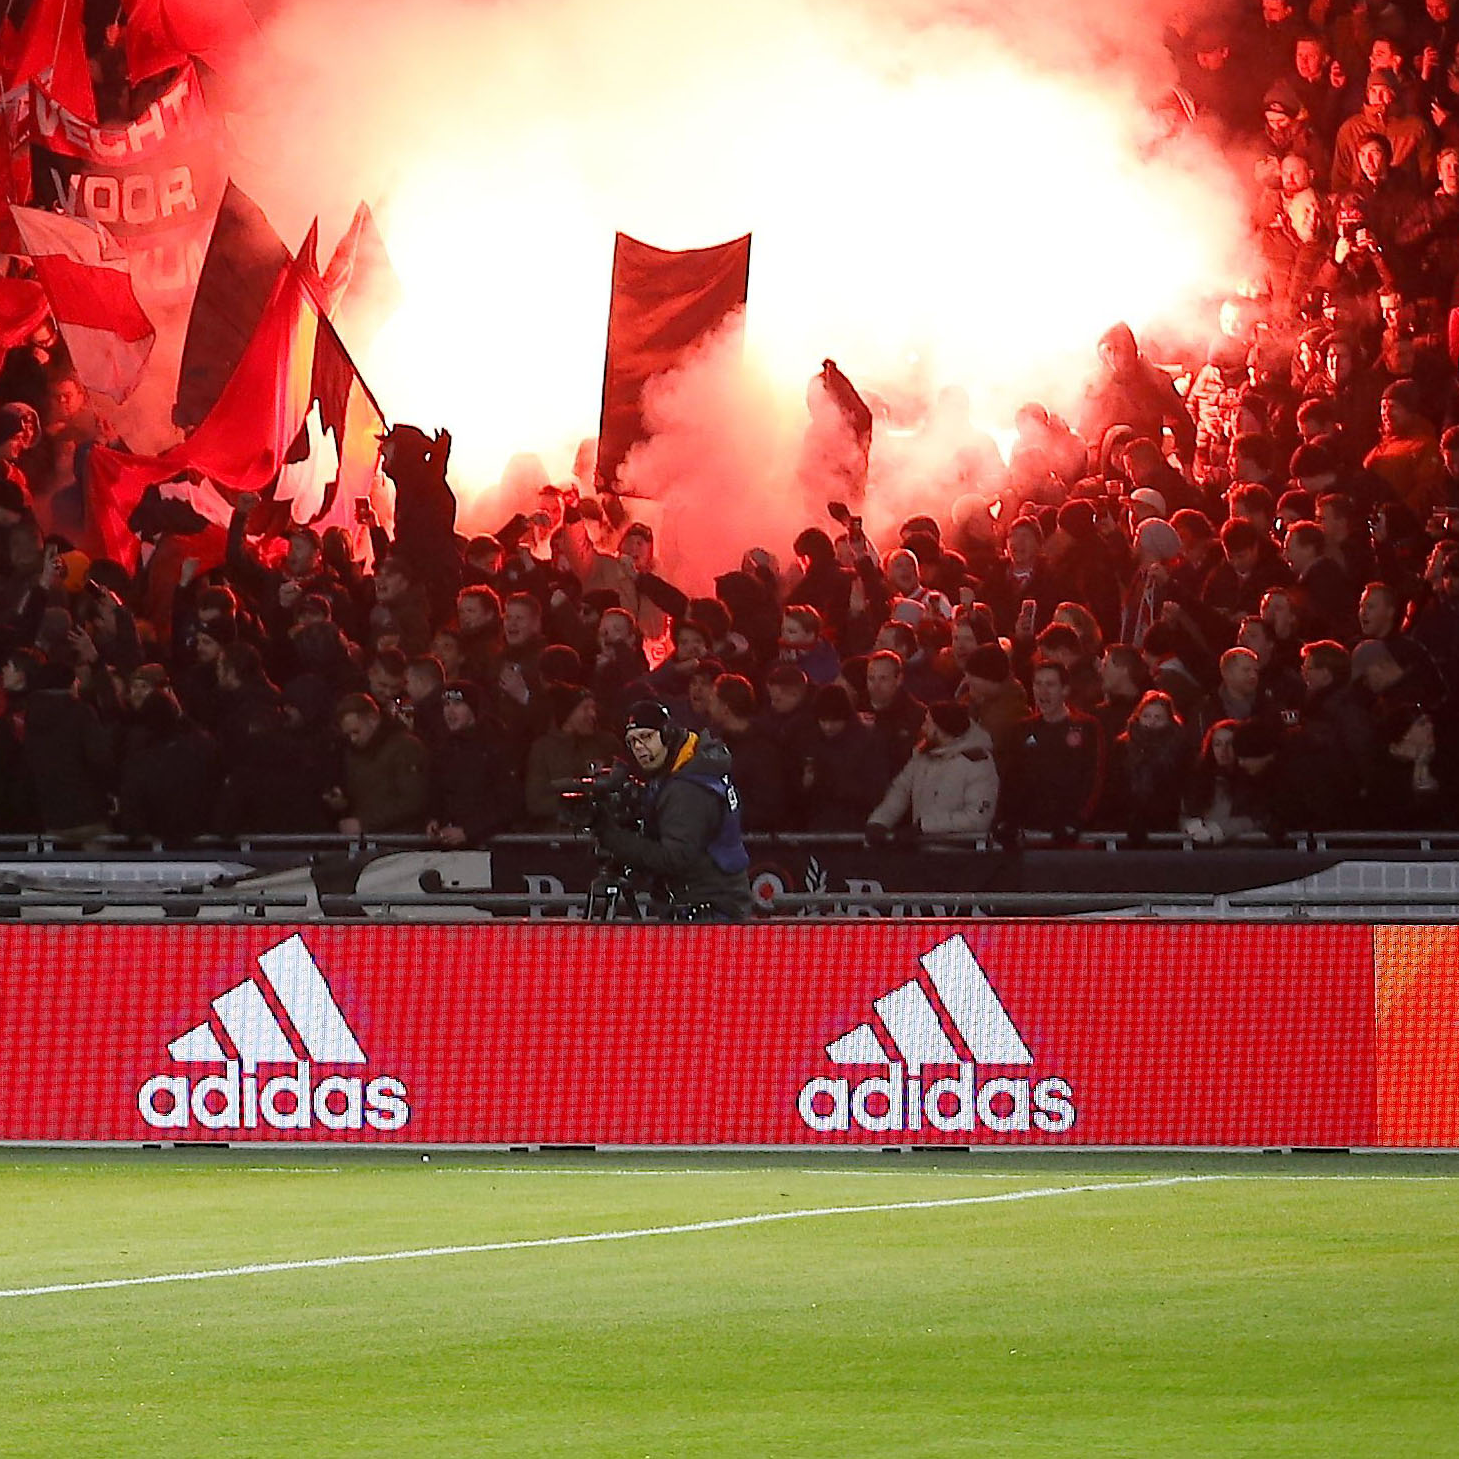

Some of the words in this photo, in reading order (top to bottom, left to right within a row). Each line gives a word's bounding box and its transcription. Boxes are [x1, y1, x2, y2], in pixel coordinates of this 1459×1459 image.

[35, 81, 189, 158] VECHT
[49, 166, 197, 224] VOOR
[137, 1058, 410, 1131] adidas
[796, 1058, 1076, 1133] adidas
